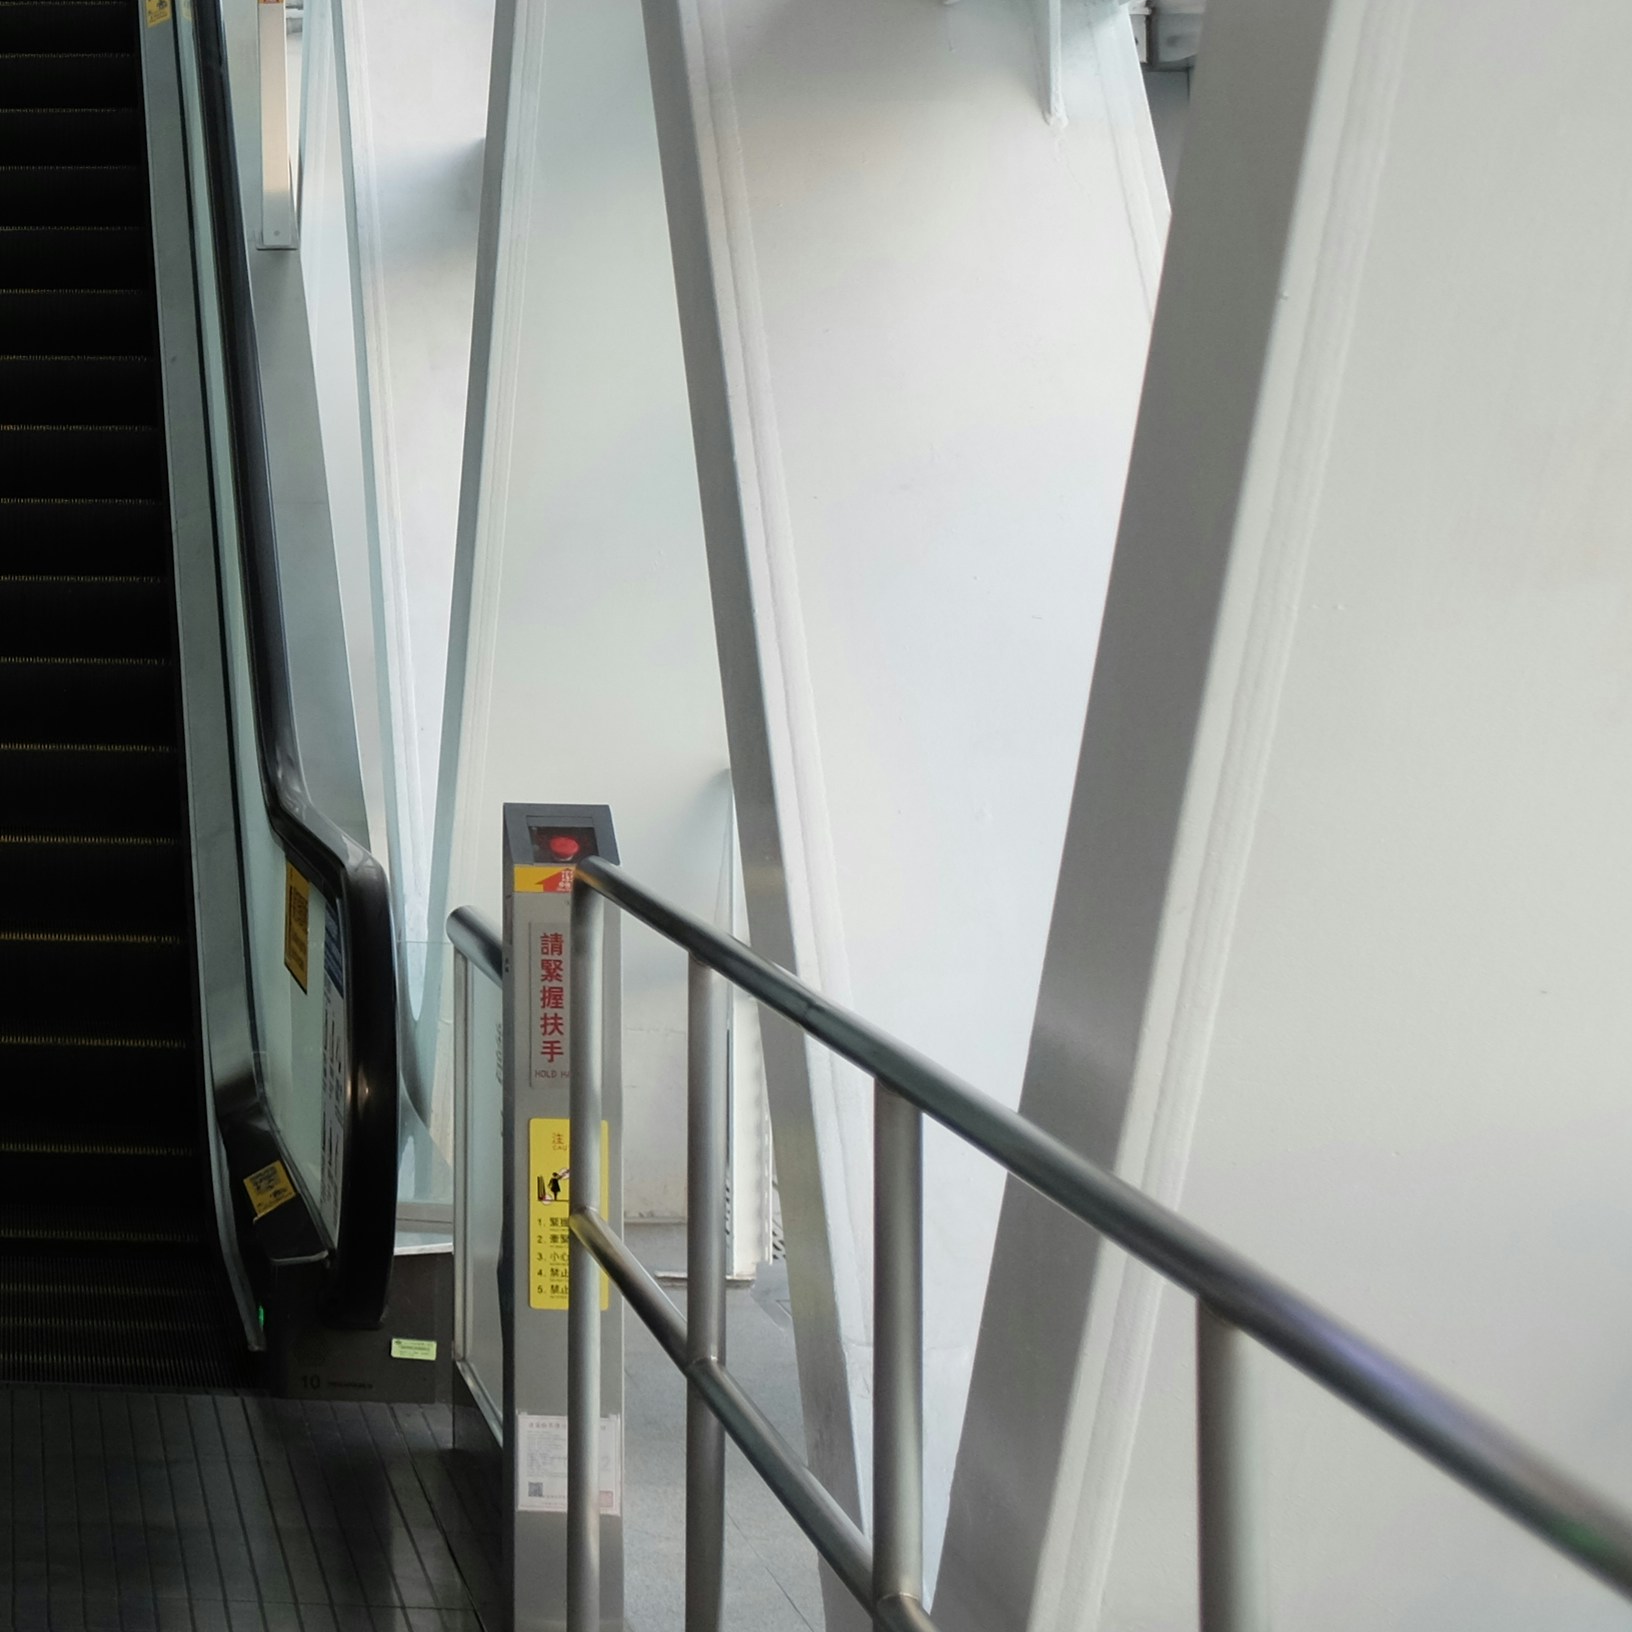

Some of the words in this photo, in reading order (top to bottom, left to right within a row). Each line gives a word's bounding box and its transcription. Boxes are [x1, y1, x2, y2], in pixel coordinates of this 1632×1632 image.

[540, 933, 564, 1063] 請緊握扶手
[535, 1069, 557, 1079] HOLD
